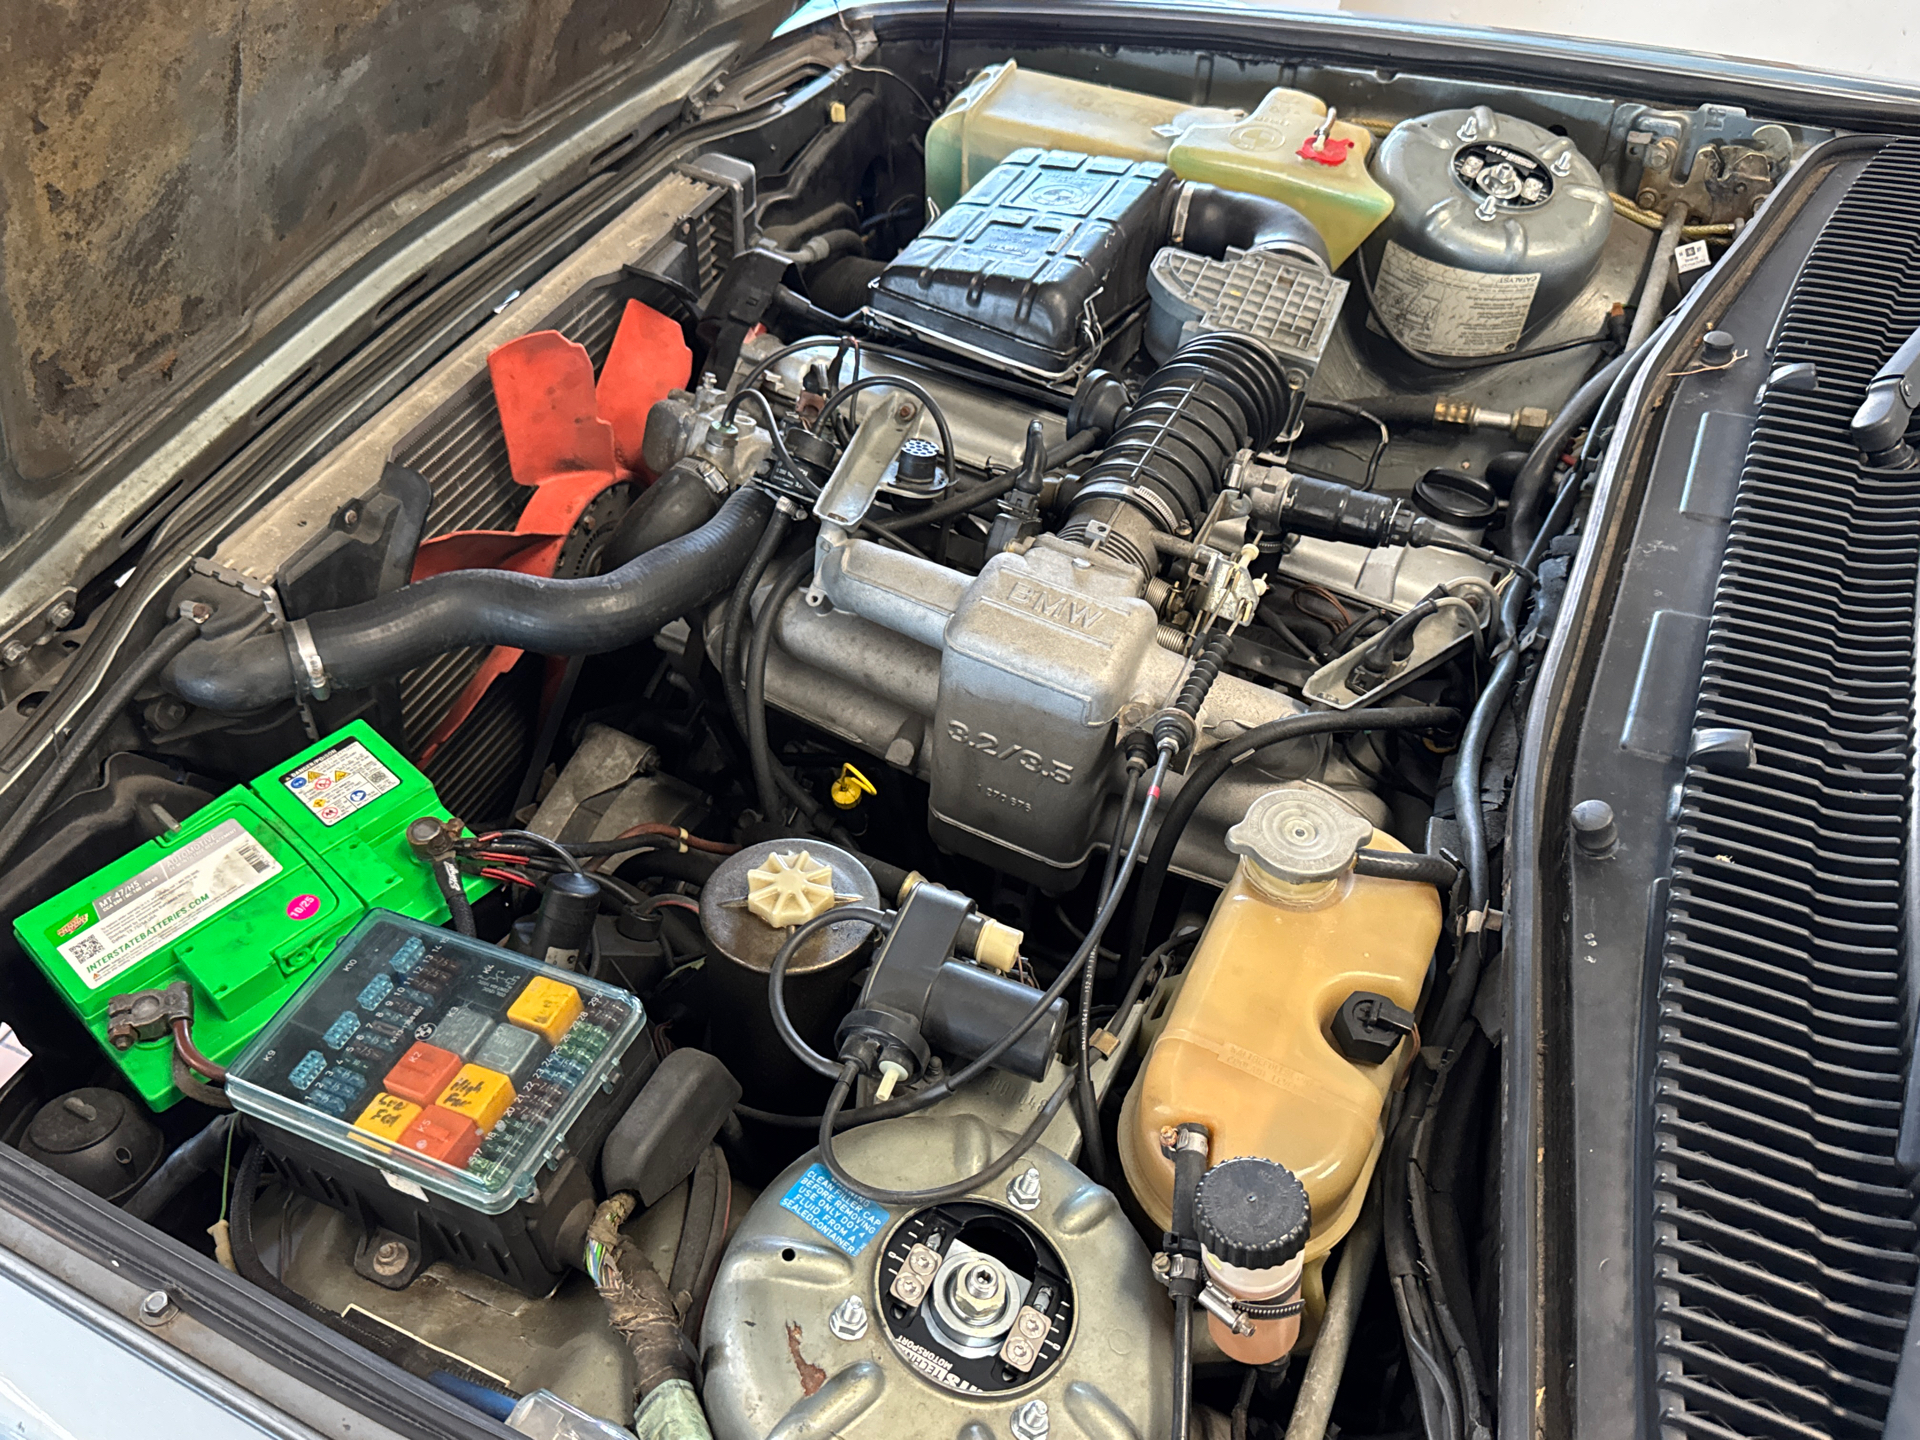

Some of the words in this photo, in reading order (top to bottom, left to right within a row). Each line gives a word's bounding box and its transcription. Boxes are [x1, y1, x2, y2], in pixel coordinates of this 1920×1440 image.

[1006, 581, 1106, 630] BMW
[290, 748, 337, 777] DANGER/POISON
[946, 719, 1075, 786] 3.2/3.5
[165, 833, 216, 868] AUTOMOTIVE
[204, 828, 236, 850] REPLACEMENT
[98, 879, 140, 908] MT-47/H5
[289, 893, 315, 920] 10/25
[86, 892, 209, 973] INTERSTATEBATTERIES.COM
[342, 957, 358, 973] K10
[482, 961, 495, 975] K4
[1083, 980, 1092, 993] 152
[315, 1080, 324, 1088] 2
[325, 1068, 334, 1077] 3
[335, 1057, 344, 1065] 4
[346, 1044, 355, 1053] 5
[356, 1033, 365, 1041] 6
[366, 1022, 374, 1030] 7
[375, 1010, 384, 1019] 8
[385, 999, 394, 1008] 9
[394, 985, 406, 997] 10
[404, 976, 414, 987] 11
[413, 965, 424, 975] 12
[423, 953, 434, 964] 13
[433, 942, 443, 953] 14
[446, 1004, 459, 1018] K3
[263, 1047, 277, 1062] K9
[408, 1049, 422, 1064] K2
[484, 1129, 496, 1142] 18
[503, 1104, 516, 1118] 20
[513, 1092, 525, 1104] 21
[522, 1079, 535, 1093] 22
[532, 1067, 545, 1080] 23
[541, 1055, 554, 1068] 24
[550, 1043, 563, 1055] 25
[559, 1031, 571, 1043] 26
[575, 1008, 589, 1023] 28
[588, 995, 599, 1007] 29
[450, 1078, 484, 1096] High
[416, 1117, 432, 1133] K5
[798, 1185, 817, 1202] USE
[817, 1199, 840, 1219] ONLY
[840, 1216, 858, 1232] DOT
[799, 1176, 835, 1203] BEFORE
[833, 1199, 876, 1234] REMOVING
[806, 1169, 834, 1191] CLEAN
[834, 1188, 861, 1212] FILLER
[862, 1210, 881, 1227] CAP
[792, 1193, 820, 1215] FLUID
[822, 1214, 848, 1236] FROM
[847, 1234, 856, 1243] A
[895, 1334, 952, 1370] MOTORSPORT
